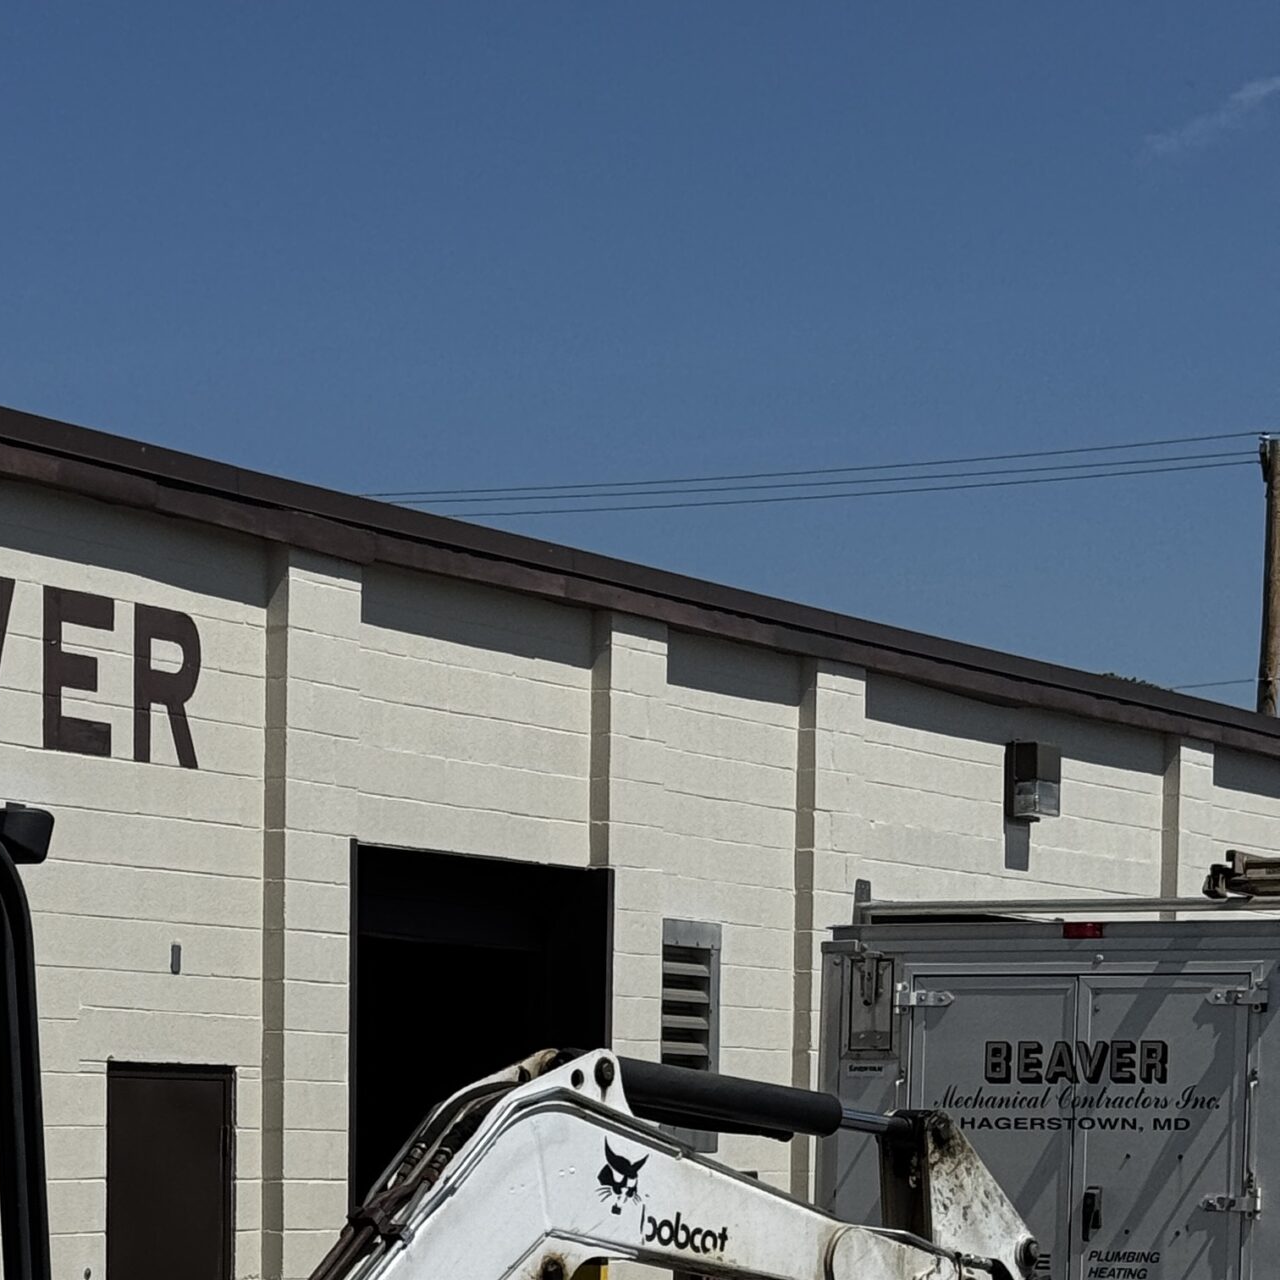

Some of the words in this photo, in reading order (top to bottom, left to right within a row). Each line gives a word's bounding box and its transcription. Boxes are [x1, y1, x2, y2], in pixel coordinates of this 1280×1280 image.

[984, 1040, 1169, 1084] BEAVER
[933, 1084, 1052, 1110] Mechanical
[1055, 1085, 1170, 1110] Contractors
[1175, 1085, 1221, 1110] Inc.
[960, 1117, 1144, 1133] HAGERSTOWN,
[1152, 1118, 1191, 1131] MD
[640, 1204, 728, 1254] bobcat
[1088, 1250, 1160, 1263] PLUMBING
[1088, 1267, 1148, 1280] HEATING
